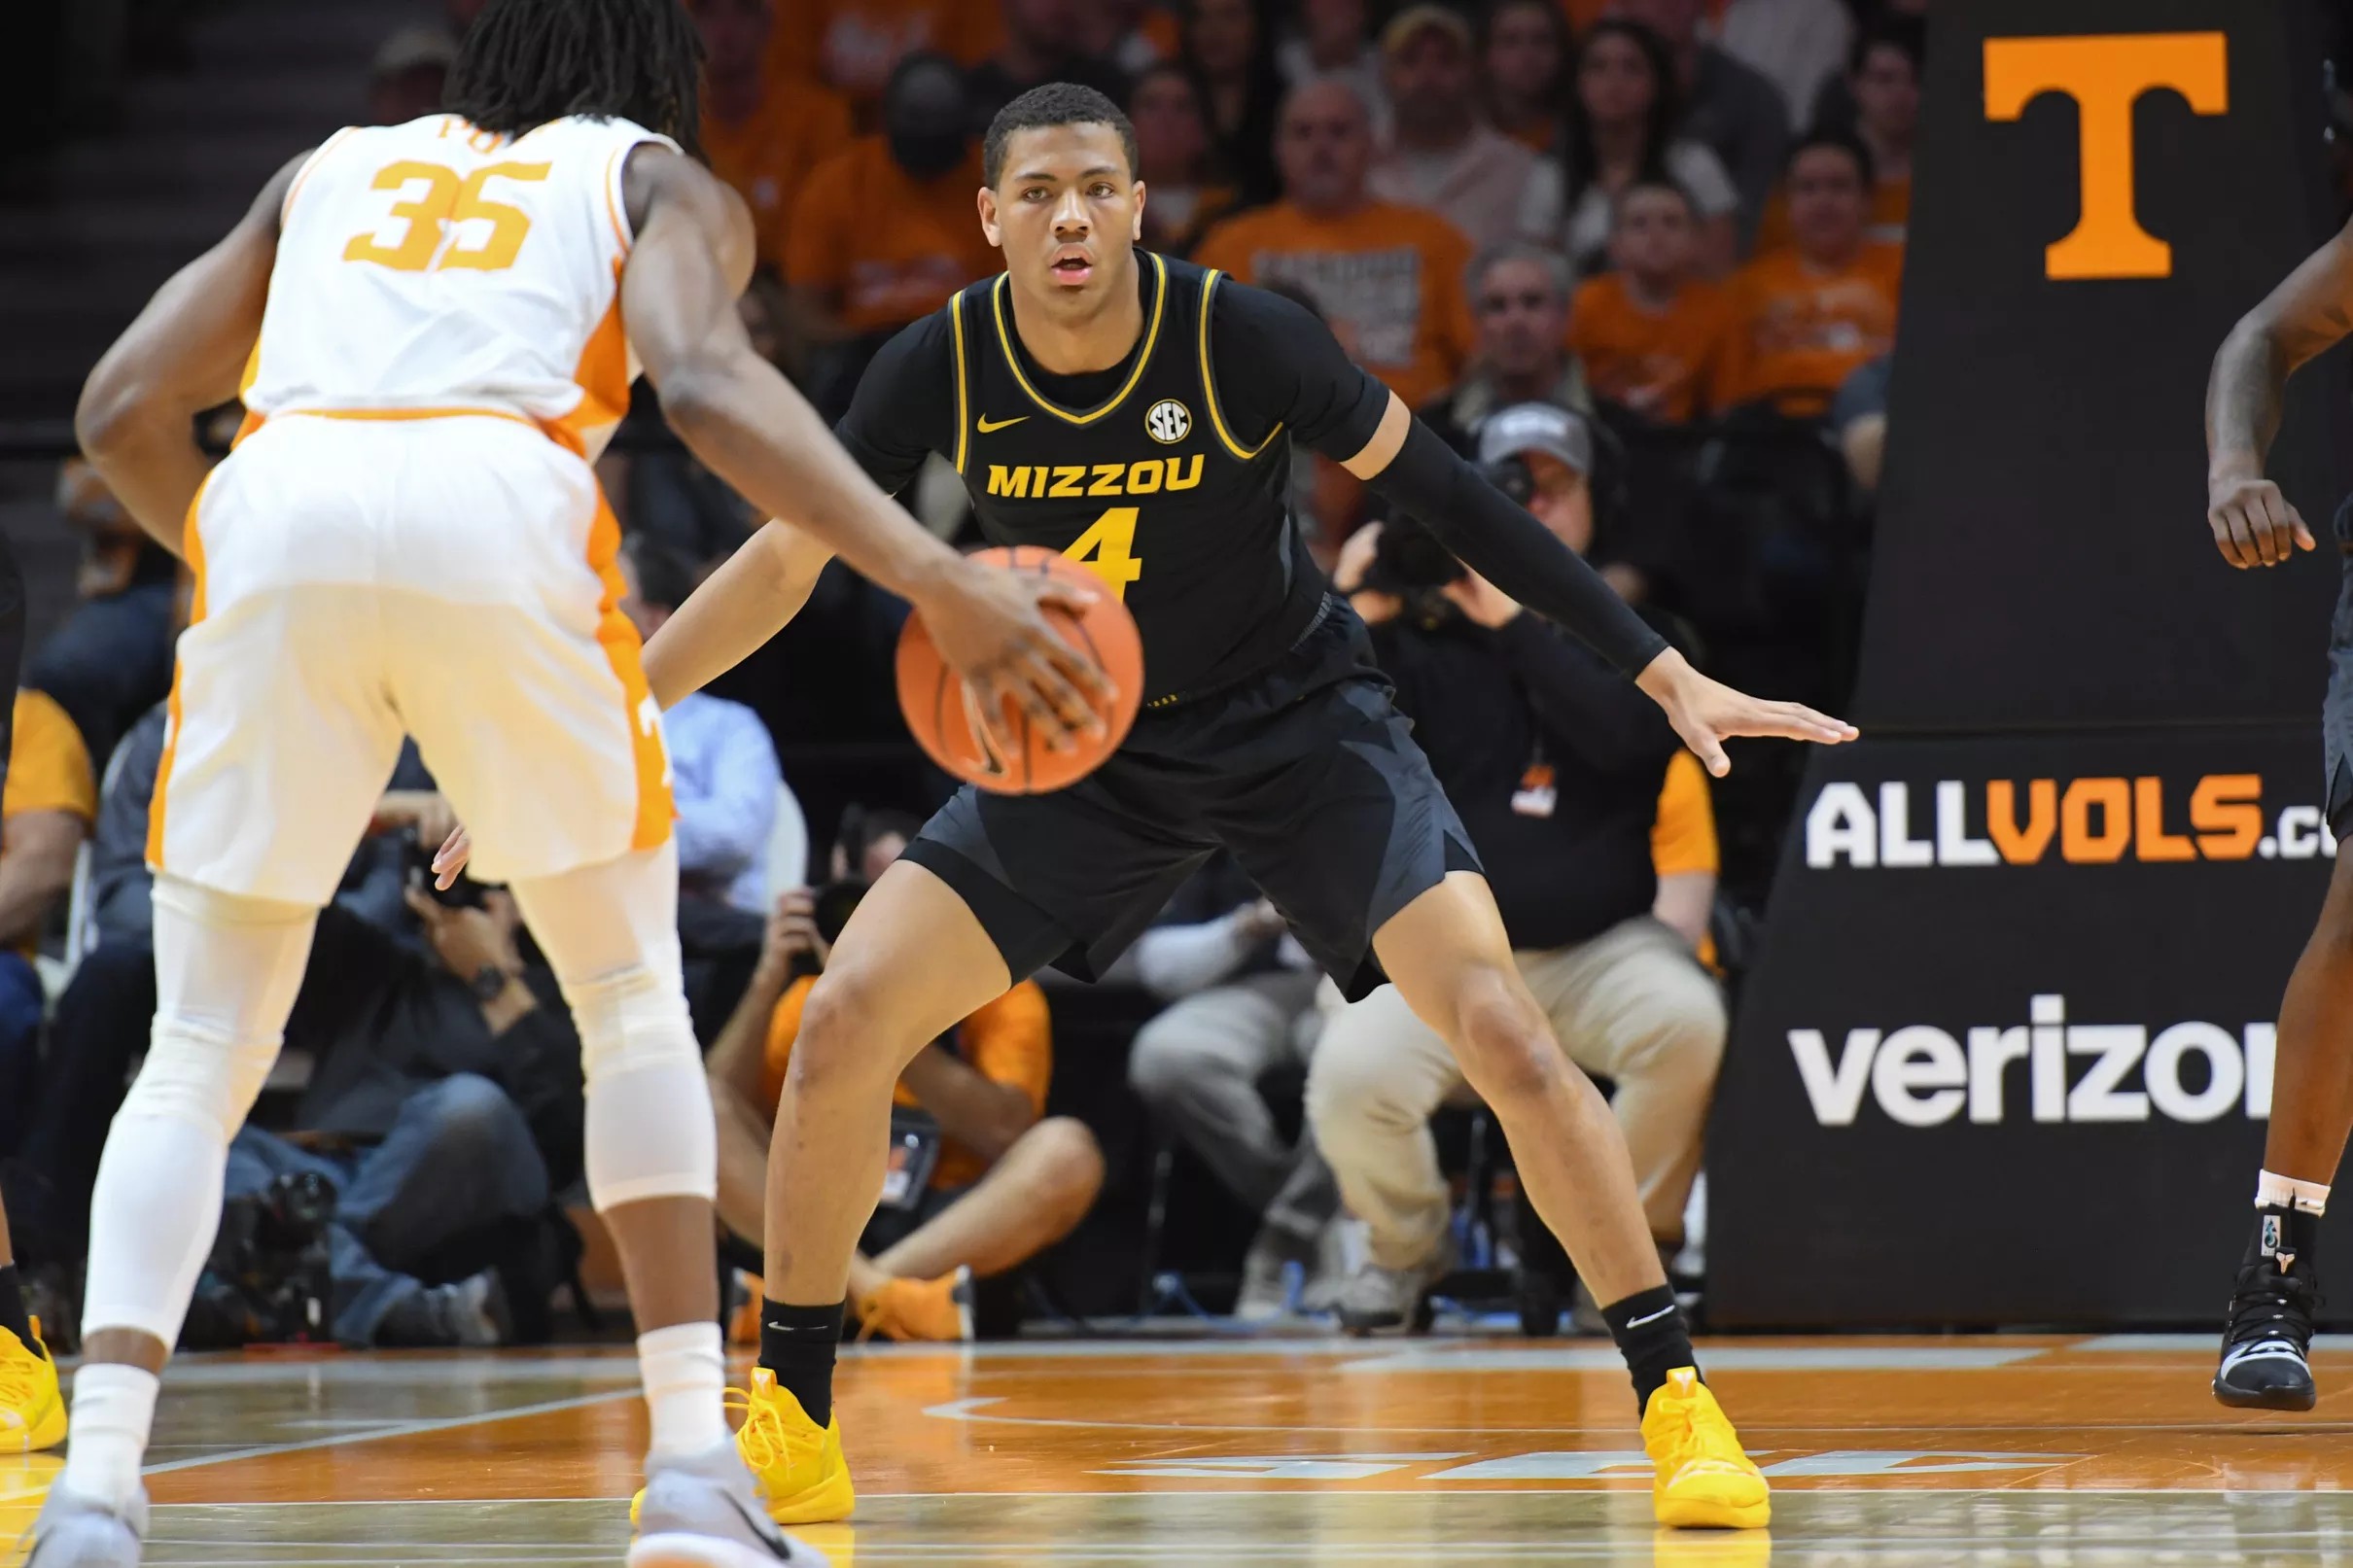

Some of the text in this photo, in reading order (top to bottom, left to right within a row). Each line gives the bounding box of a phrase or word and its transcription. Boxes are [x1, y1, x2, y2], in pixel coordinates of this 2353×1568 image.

[342, 158, 553, 272] 35
[1148, 401, 1188, 441] SEC
[987, 454, 1205, 499] MIZZOU
[1061, 506, 1142, 608] 4
